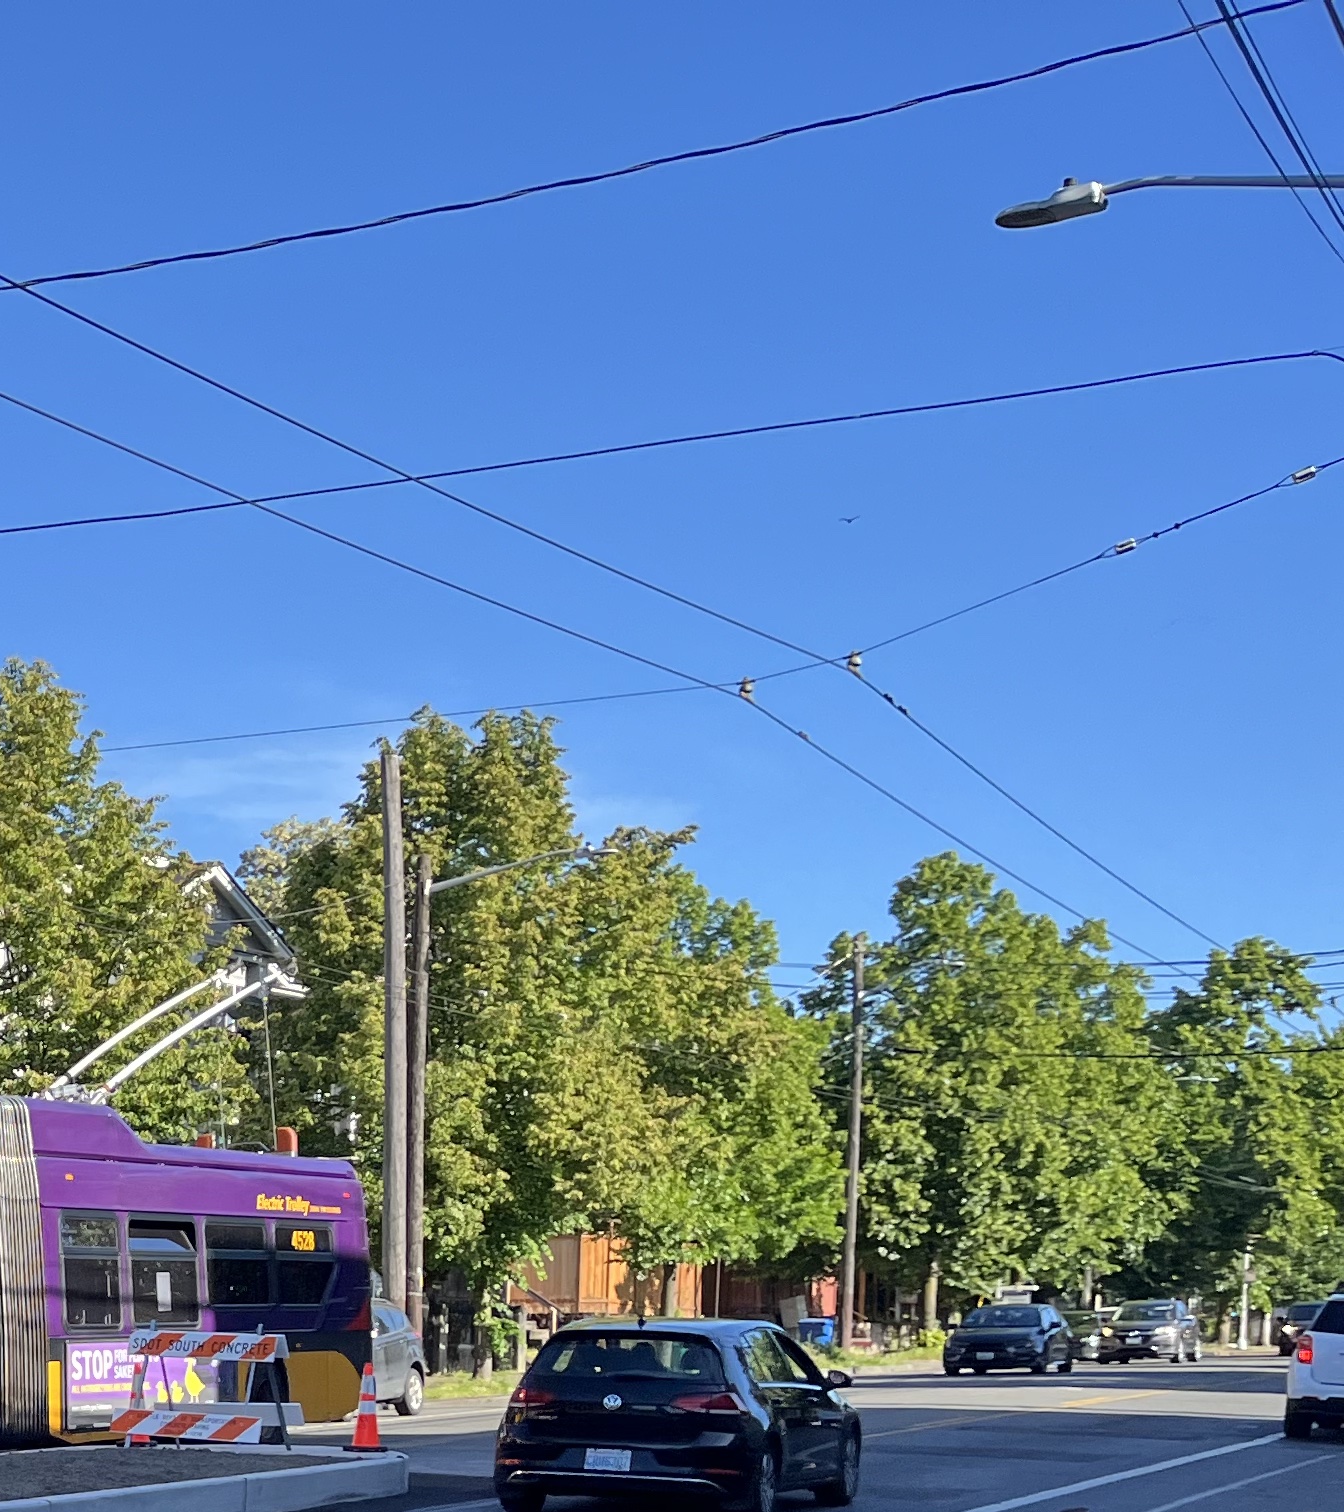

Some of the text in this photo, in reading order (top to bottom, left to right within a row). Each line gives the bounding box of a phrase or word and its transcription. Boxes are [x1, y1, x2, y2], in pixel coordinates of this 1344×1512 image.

[291, 1229, 316, 1251] 4528
[132, 1337, 270, 1356] SDOT SOUTH CONCRETE
[71, 1349, 114, 1381] STOP
